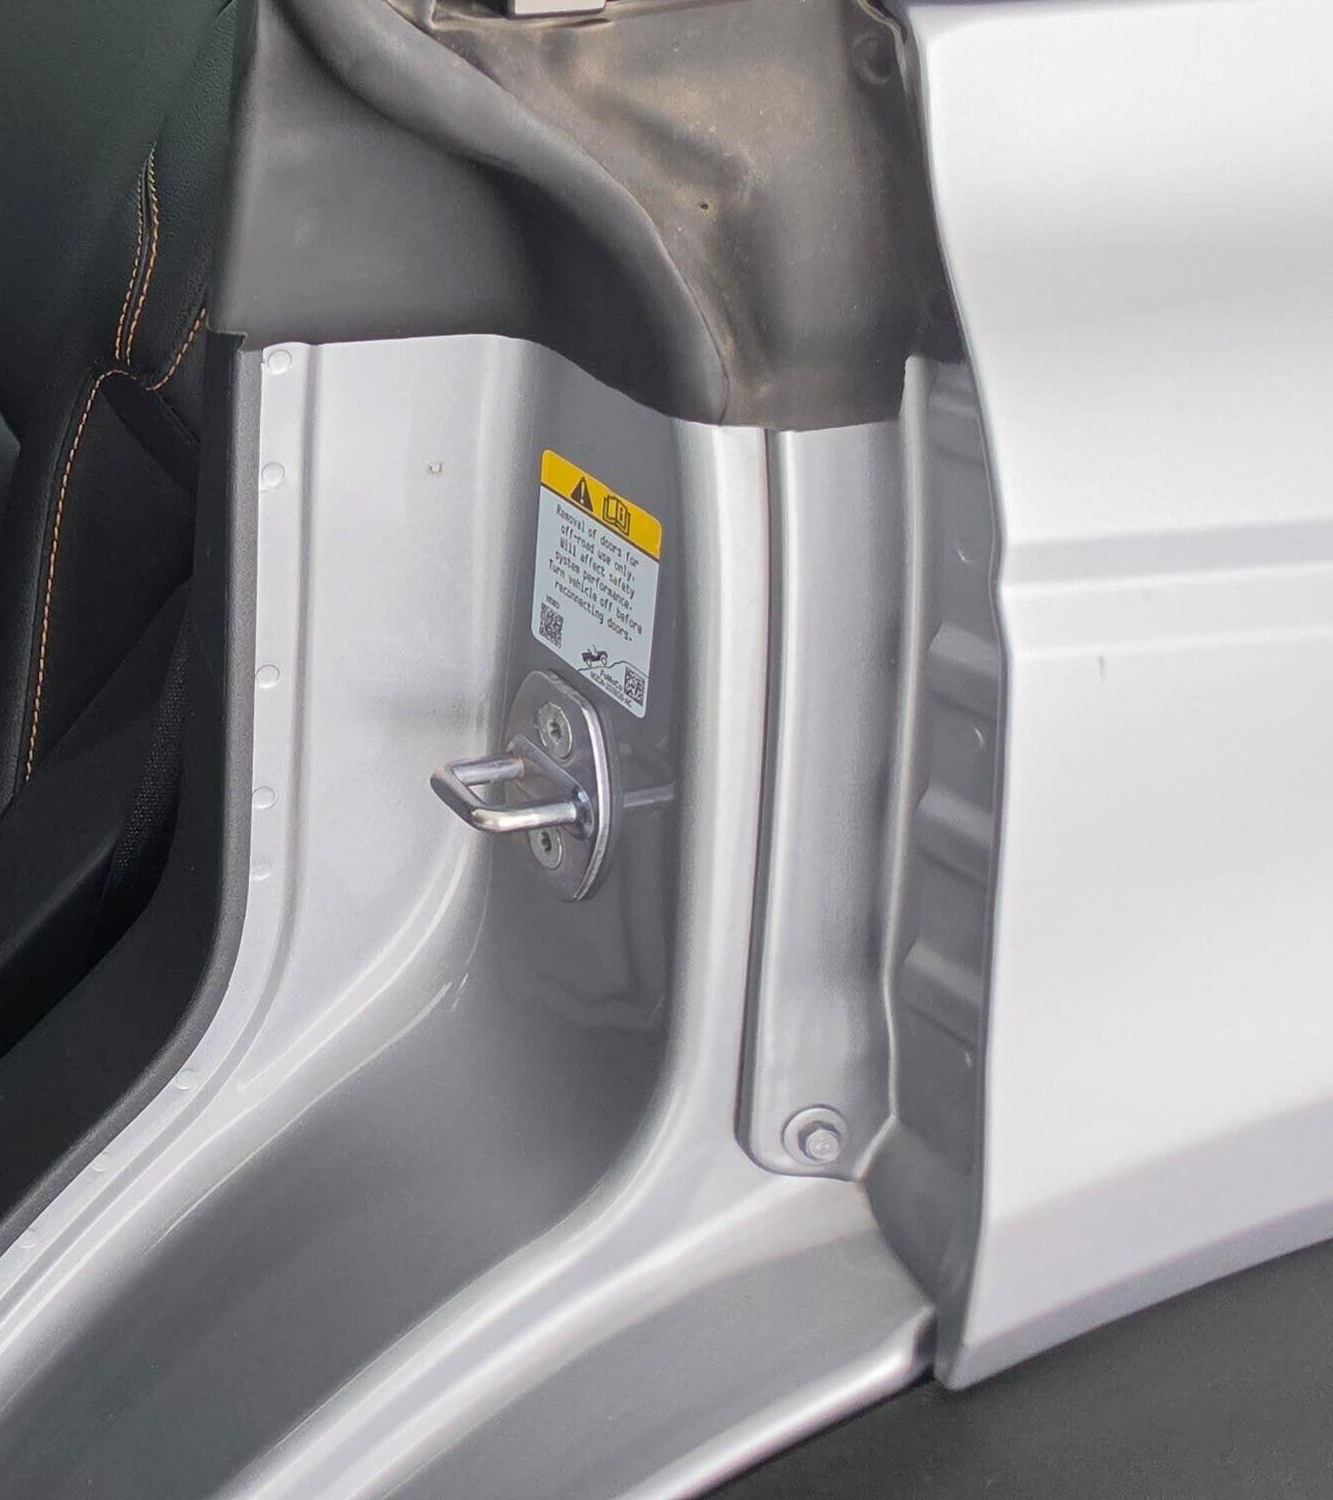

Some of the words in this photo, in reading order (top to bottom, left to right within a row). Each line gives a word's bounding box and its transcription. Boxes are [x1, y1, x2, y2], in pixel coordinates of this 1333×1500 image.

[556, 504, 585, 533] Removal
[588, 529, 597, 539] of
[600, 536, 622, 557] doors
[626, 551, 639, 567] for
[561, 525, 594, 554] off-road
[598, 550, 611, 565] use
[614, 562, 635, 581] only.
[549, 559, 565, 579] Turn
[569, 575, 597, 602] vehicle
[600, 598, 613, 612] off
[616, 607, 642, 634] before
[555, 550, 580, 574] system
[583, 570, 632, 610] performance.
[560, 536, 576, 557] Will
[581, 554, 605, 577] affect
[609, 573, 635, 600] safety
[555, 581, 604, 625] reconnecting
[607, 618, 632, 641] doors.
